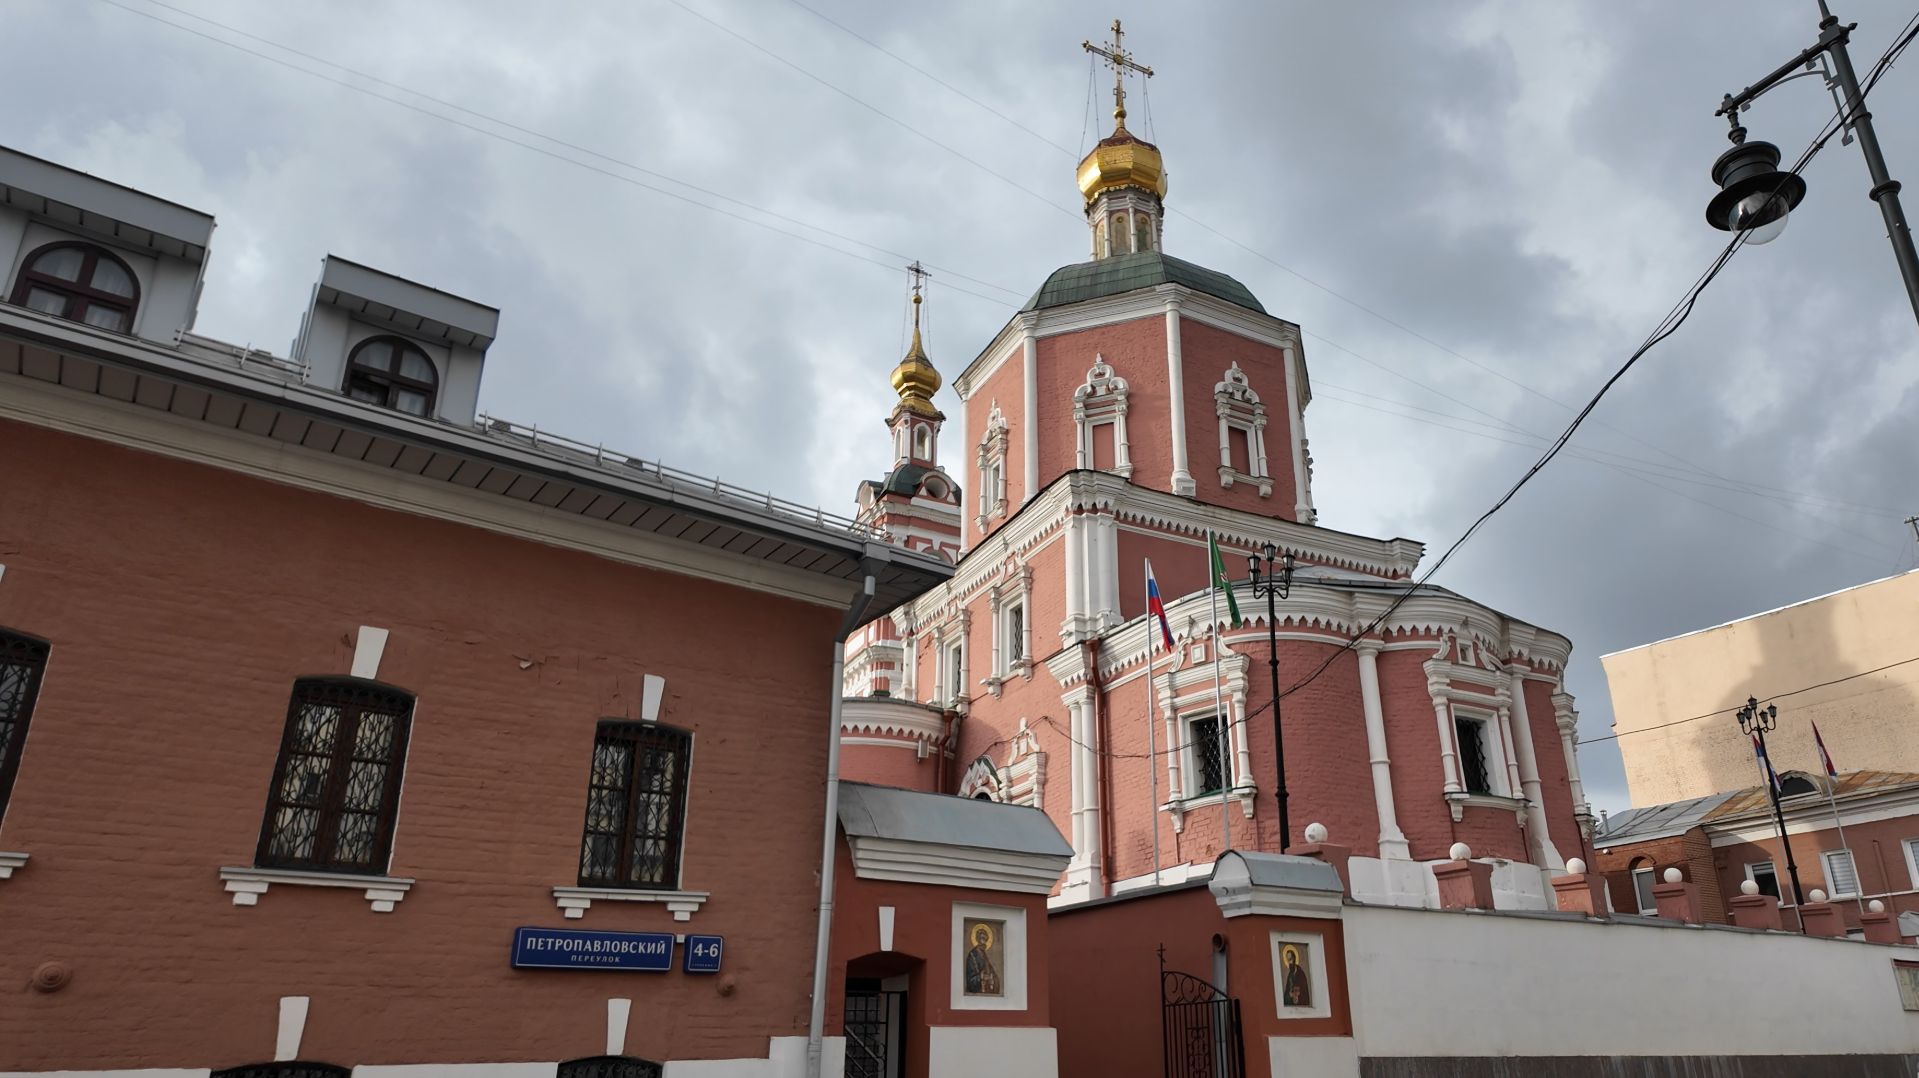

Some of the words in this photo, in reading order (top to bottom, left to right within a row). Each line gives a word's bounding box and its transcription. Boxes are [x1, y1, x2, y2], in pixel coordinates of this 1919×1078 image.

[526, 937, 666, 954] ПЕТРОПАВЛОВСКИЙ
[693, 943, 719, 958] 4-6
[571, 954, 621, 963] ПЕРЕУЛОК
